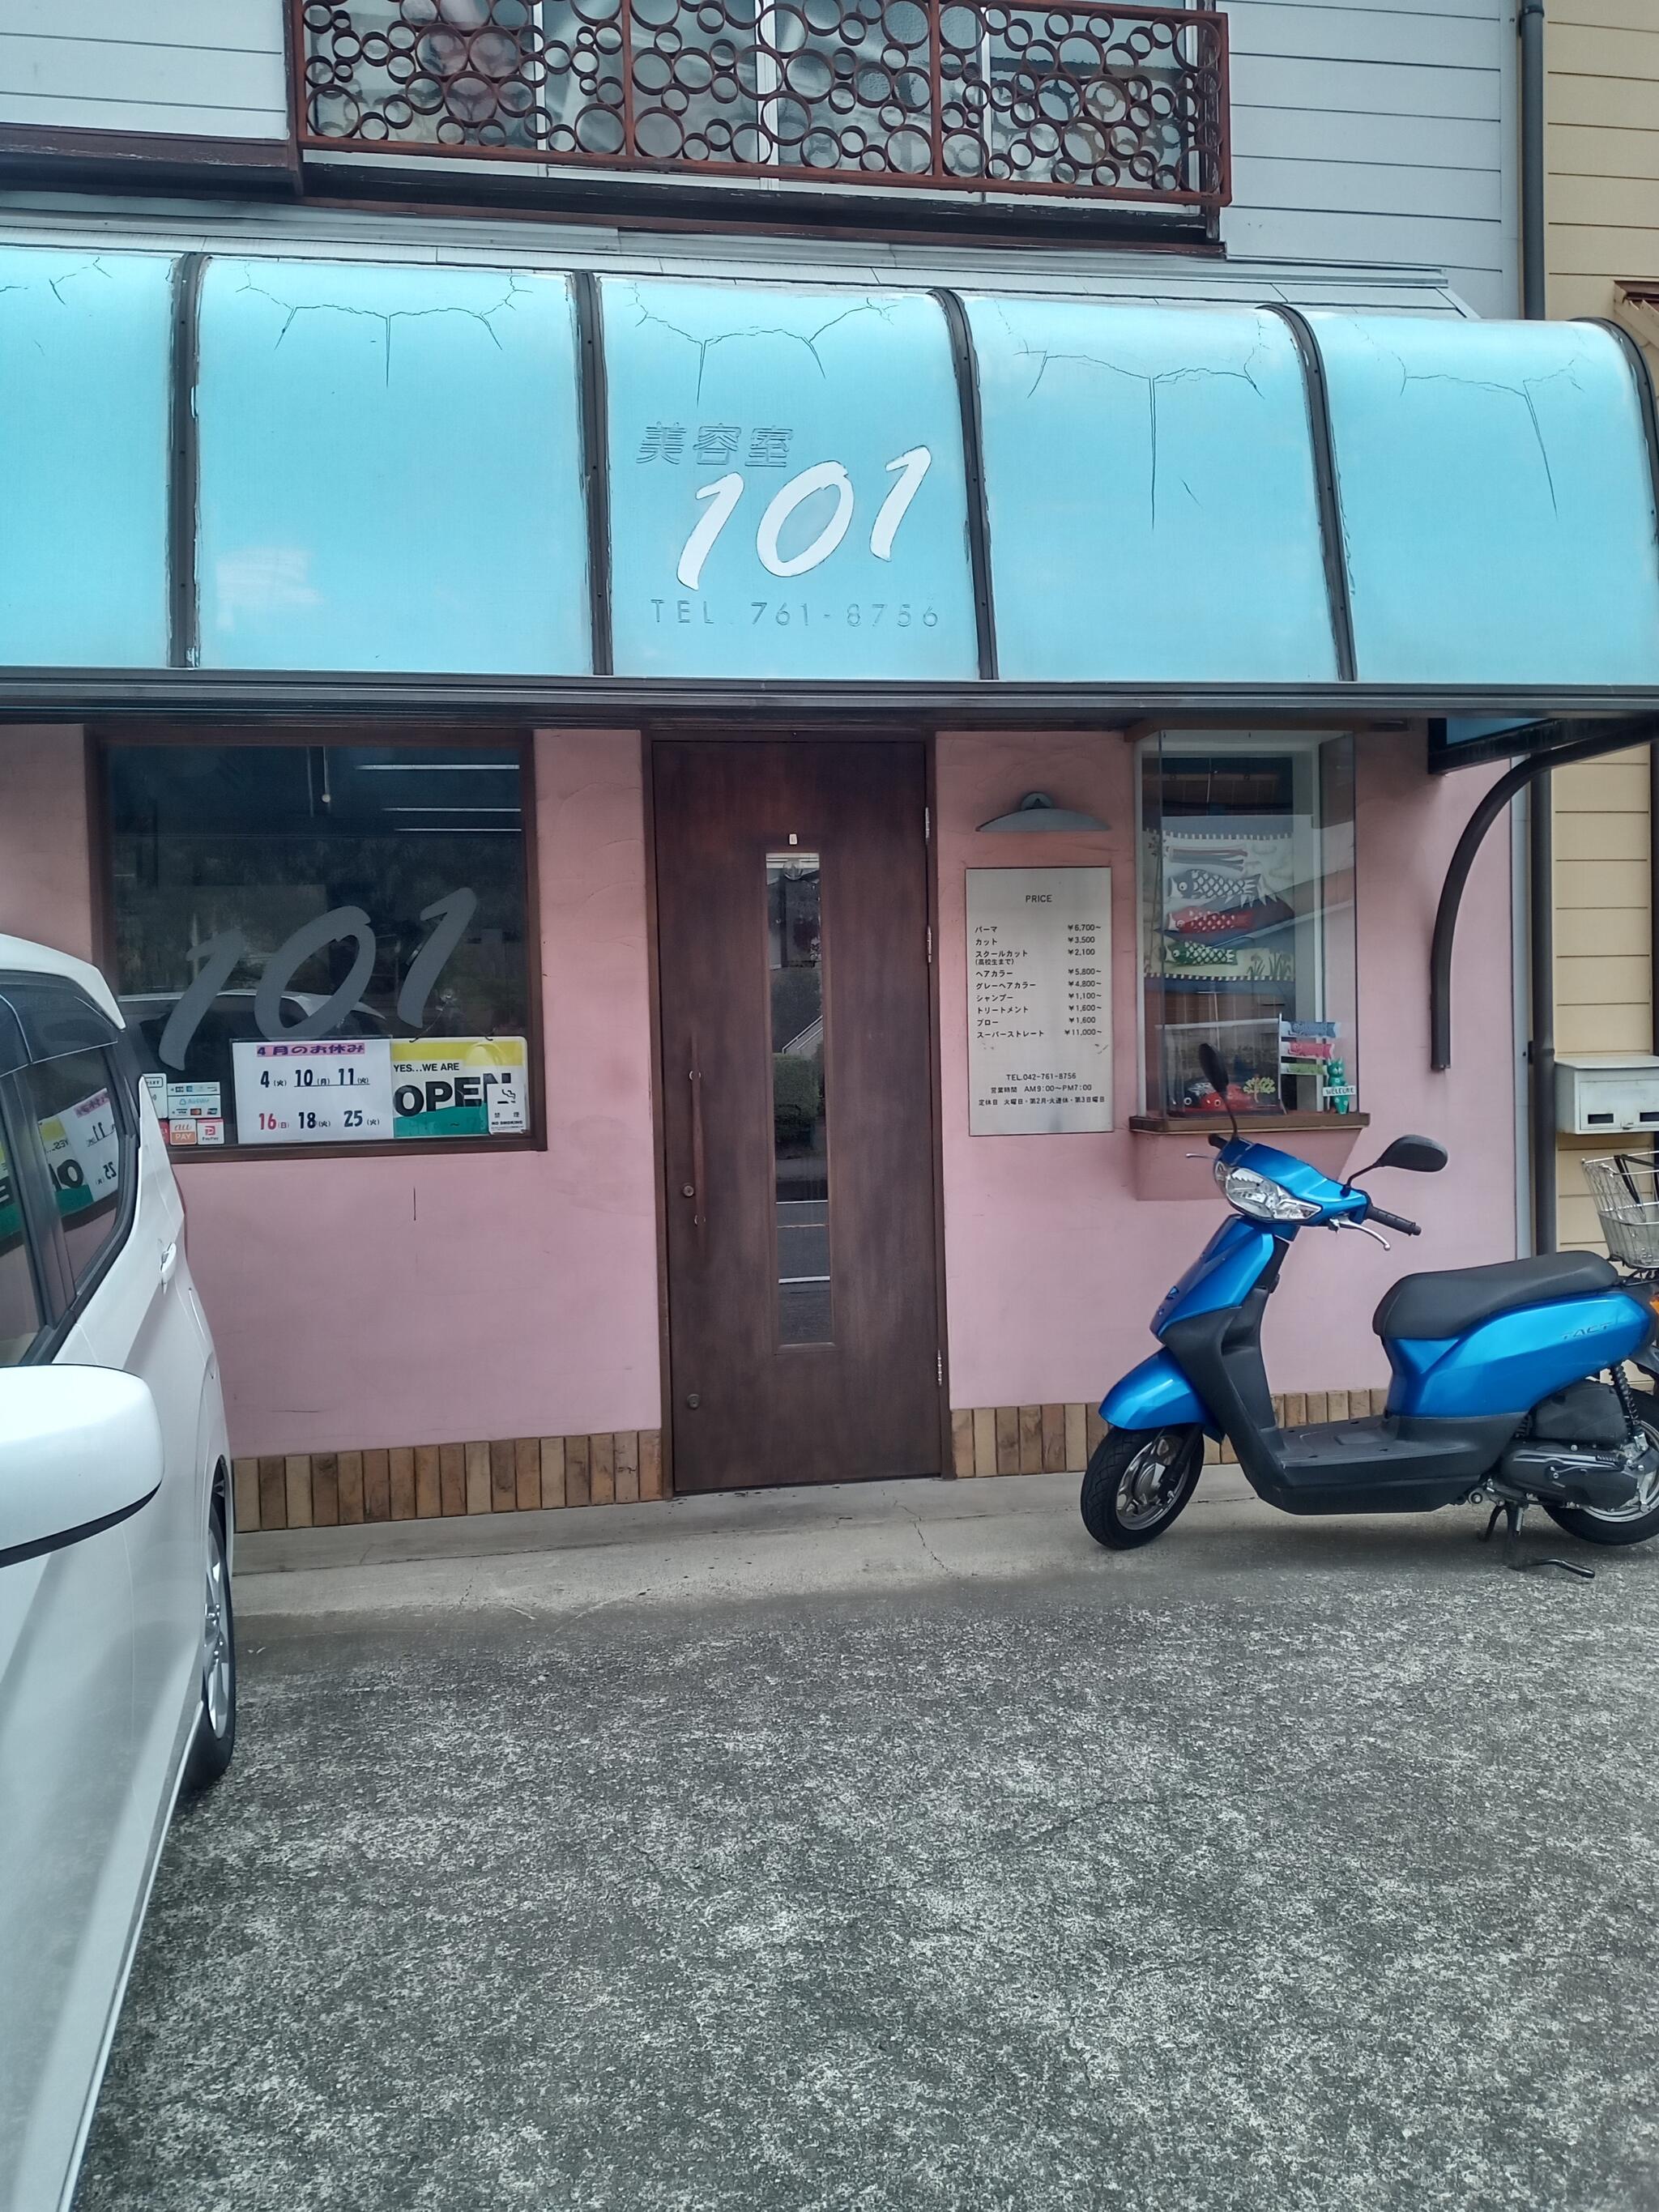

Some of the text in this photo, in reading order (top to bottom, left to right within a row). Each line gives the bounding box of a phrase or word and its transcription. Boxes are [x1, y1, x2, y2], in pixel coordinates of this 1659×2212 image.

[636, 421, 794, 468] 美容室
[676, 445, 932, 590] 101
[751, 601, 940, 628] 761-8756
[1026, 894, 1052, 903] PRICE
[975, 938, 998, 946] カット
[975, 949, 1028, 957] スクールカット
[975, 970, 1013, 978] ヘアカラー
[159, 887, 477, 1072] 101
[976, 981, 1036, 990] グレーヘアカラー
[976, 994, 1013, 1002] シャンプー
[978, 1006, 1029, 1014] トリートメント
[977, 1018, 998, 1026] ブロー
[256, 1043, 365, 1056] 4月のお休み
[440, 1063, 459, 1071] ARE
